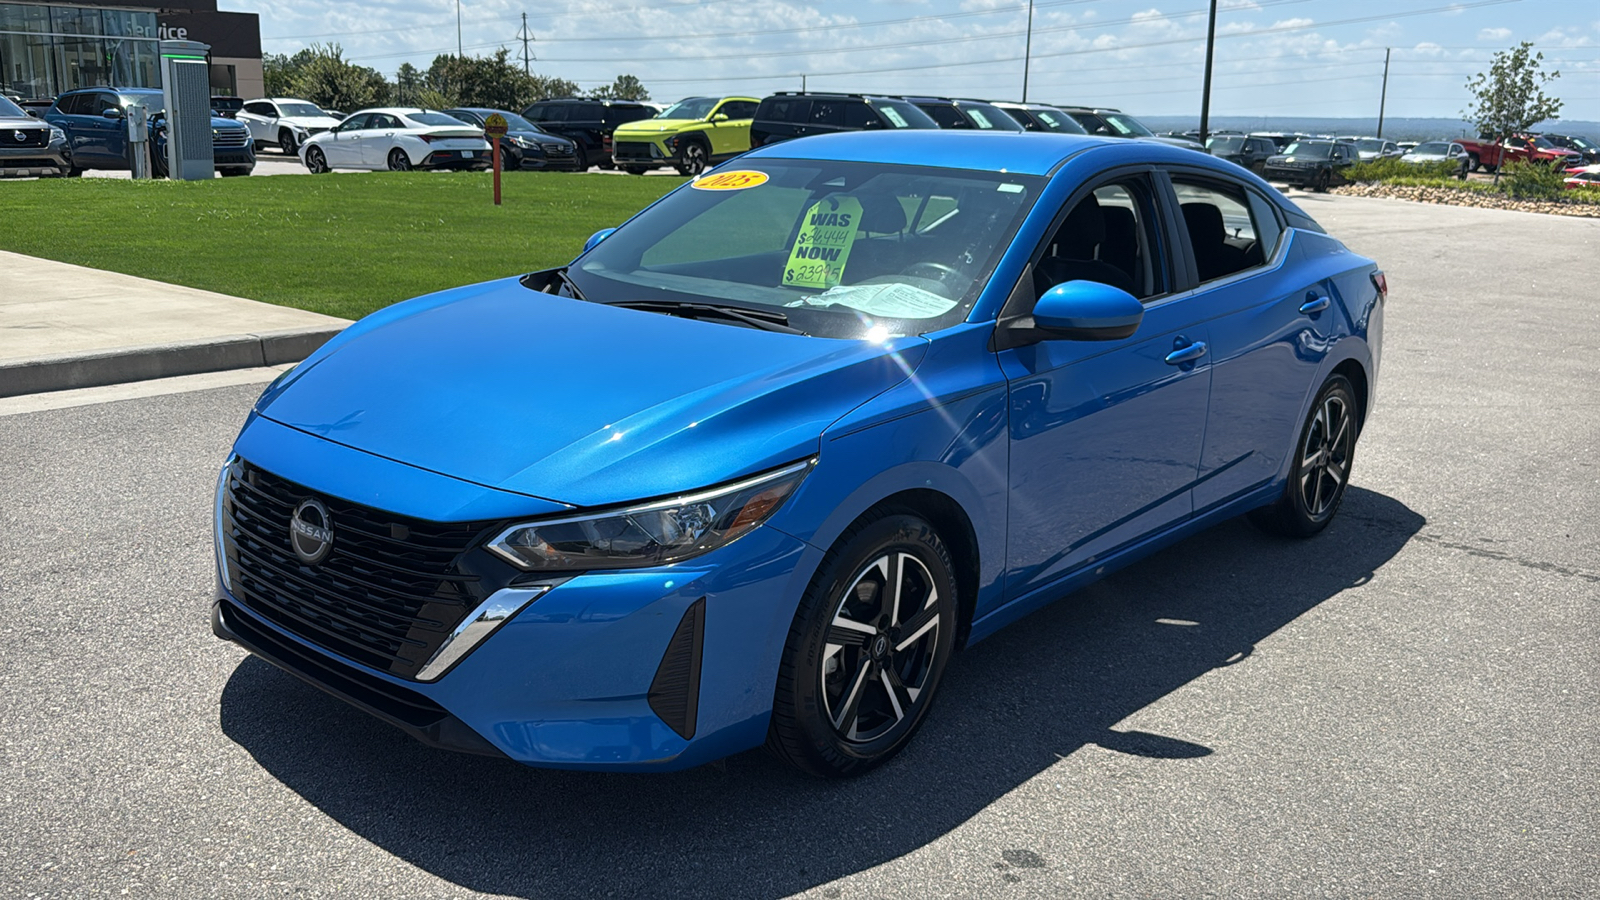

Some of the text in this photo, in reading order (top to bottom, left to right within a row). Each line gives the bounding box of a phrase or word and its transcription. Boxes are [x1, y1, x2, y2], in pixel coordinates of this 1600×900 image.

[698, 174, 761, 187] 2025
[810, 213, 852, 227] WAS
[795, 246, 843, 261] NOW
[291, 519, 331, 542] NISSAN
